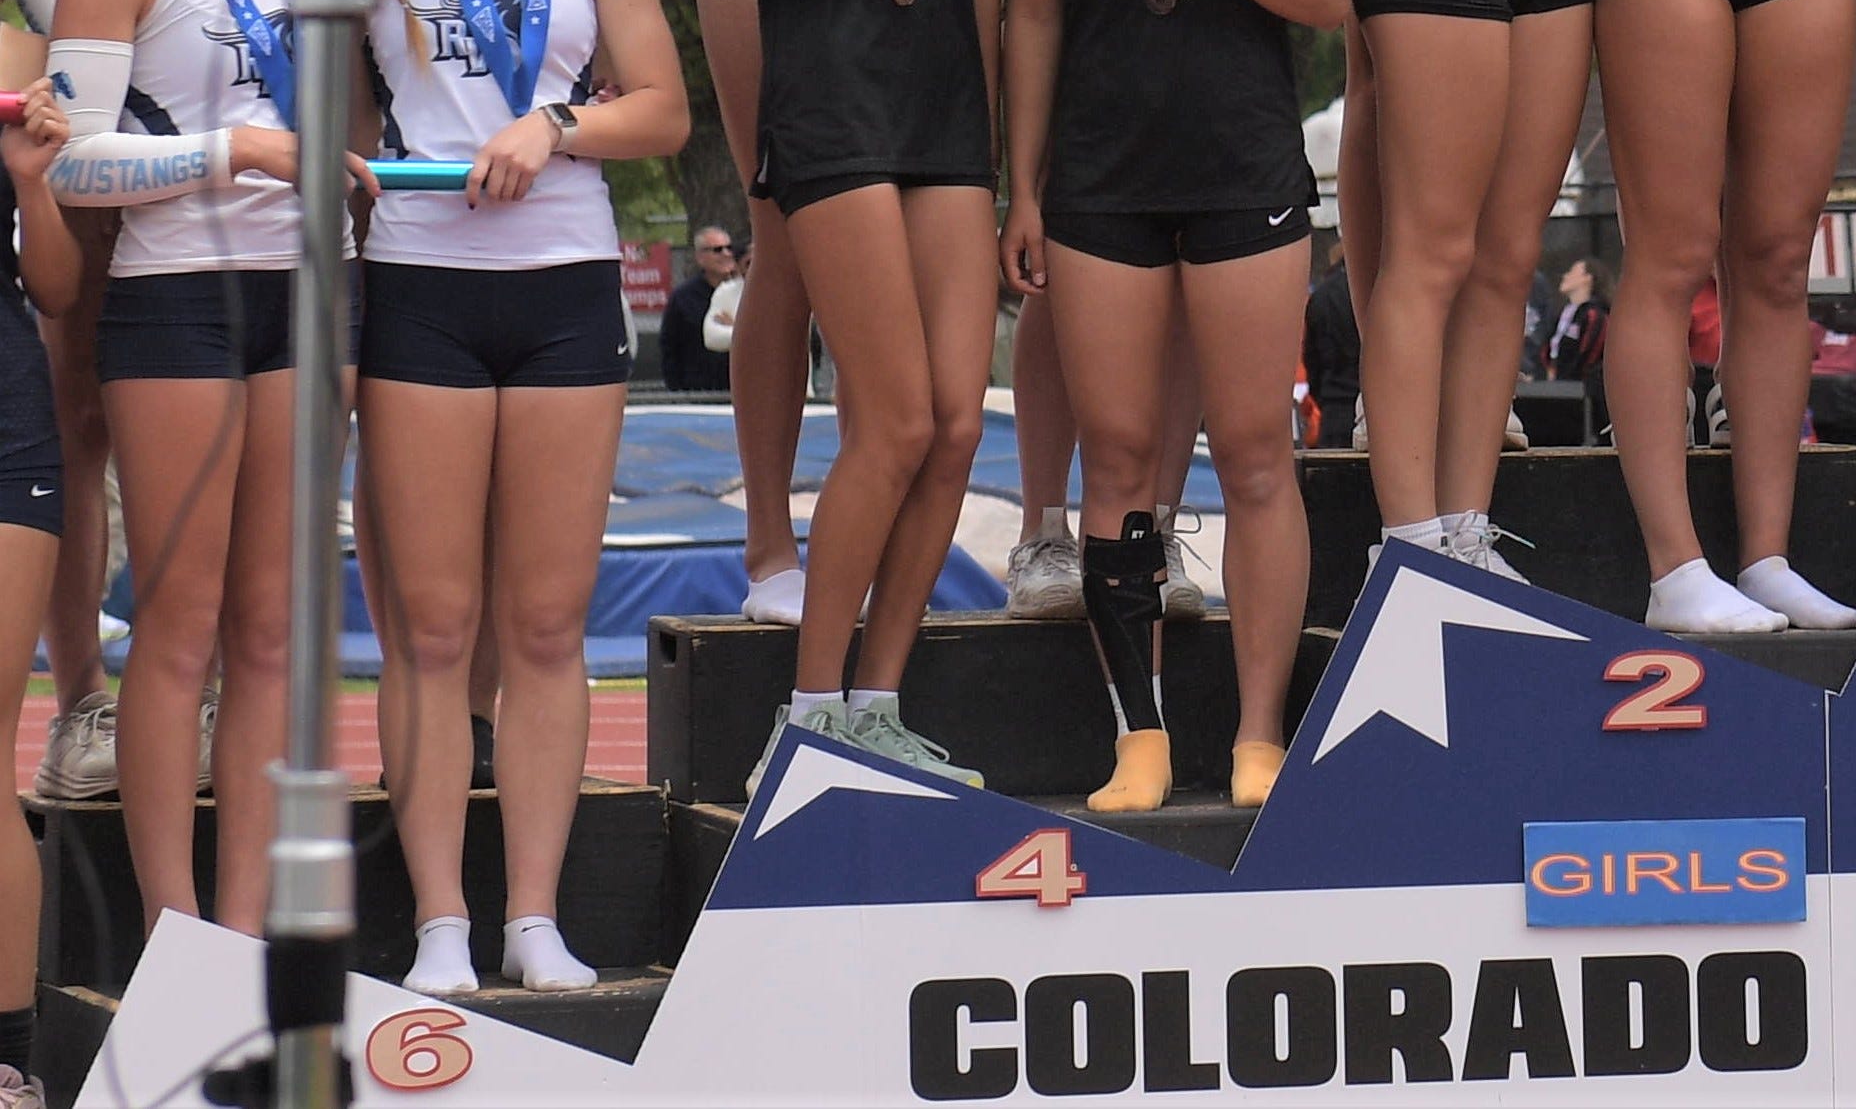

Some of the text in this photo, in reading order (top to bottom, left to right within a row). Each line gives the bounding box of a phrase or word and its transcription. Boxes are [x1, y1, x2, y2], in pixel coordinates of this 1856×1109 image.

[52, 151, 208, 195] MUSTANGS
[1602, 650, 1708, 732] 2
[975, 828, 1087, 908] 4
[1530, 849, 1791, 897] GIRLS
[365, 1007, 473, 1092] 6
[909, 951, 1808, 1102] COLORADO
